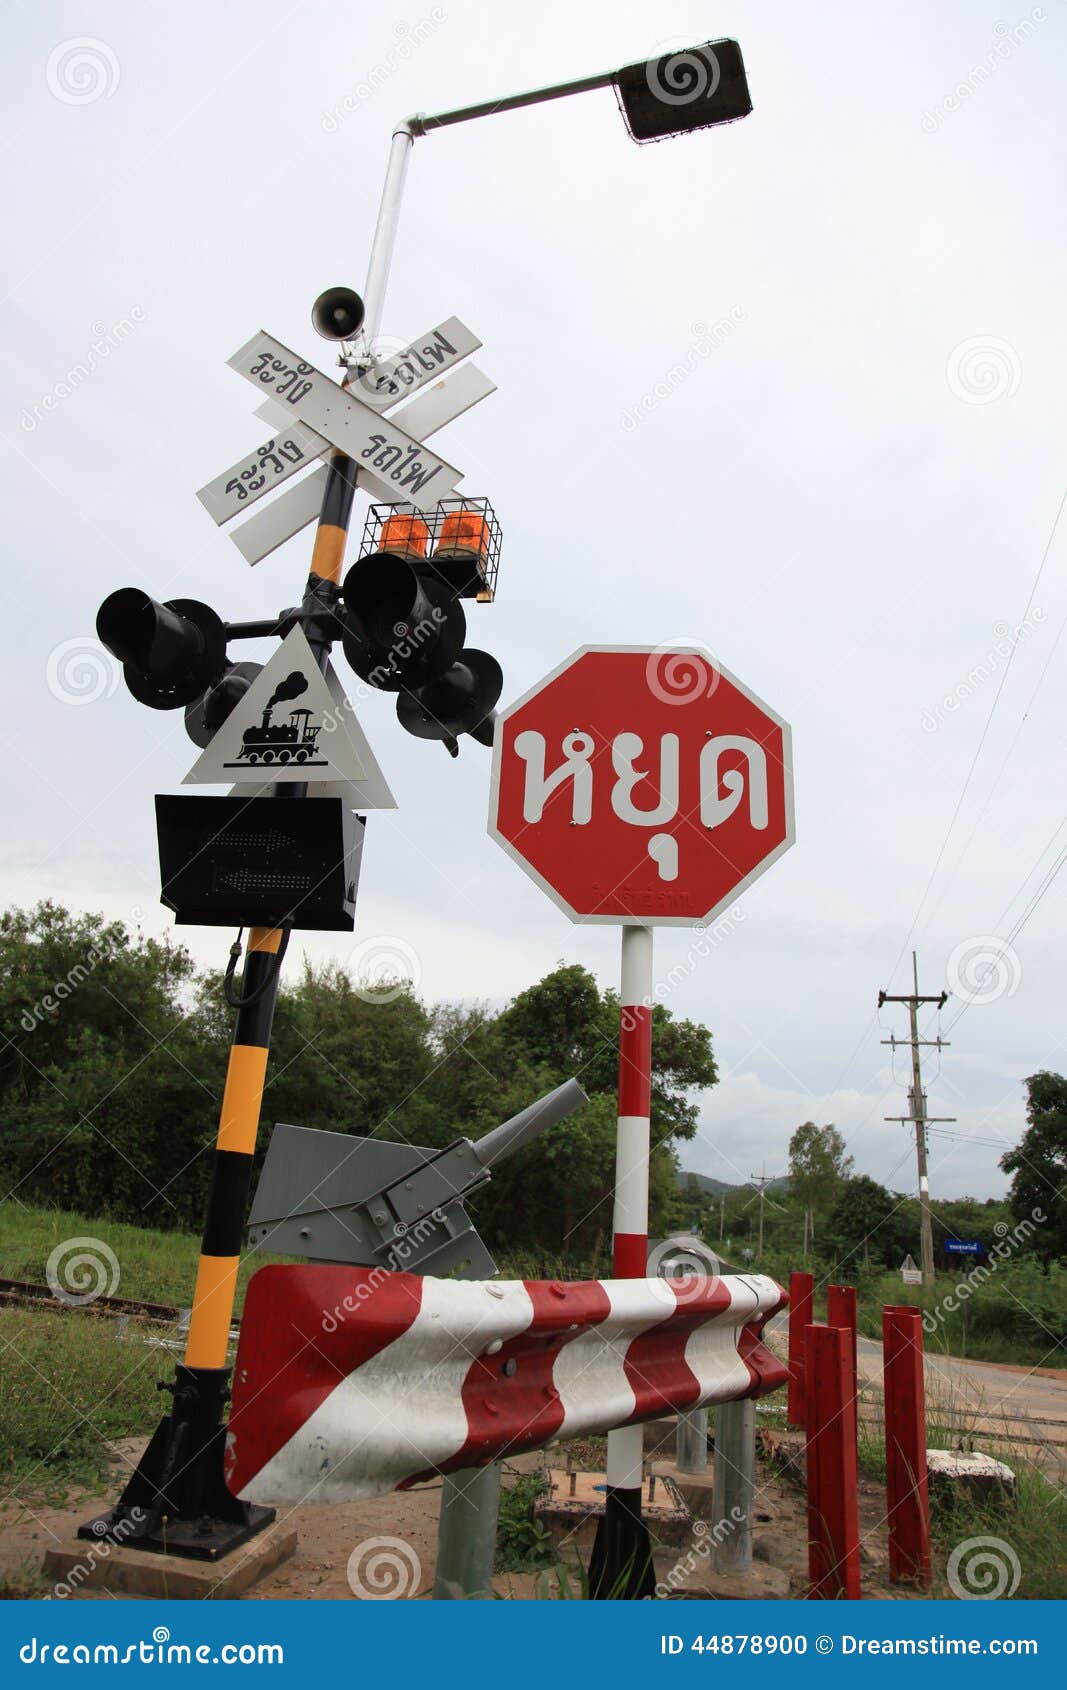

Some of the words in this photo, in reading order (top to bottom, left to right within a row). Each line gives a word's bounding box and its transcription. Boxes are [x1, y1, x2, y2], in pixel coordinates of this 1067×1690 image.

[225, 440, 304, 500] ระวัง
[376, 330, 458, 395] รถไฟ
[250, 352, 316, 405] ระวัง
[361, 434, 443, 496] รถไฟ
[514, 730, 769, 882] หยุด
